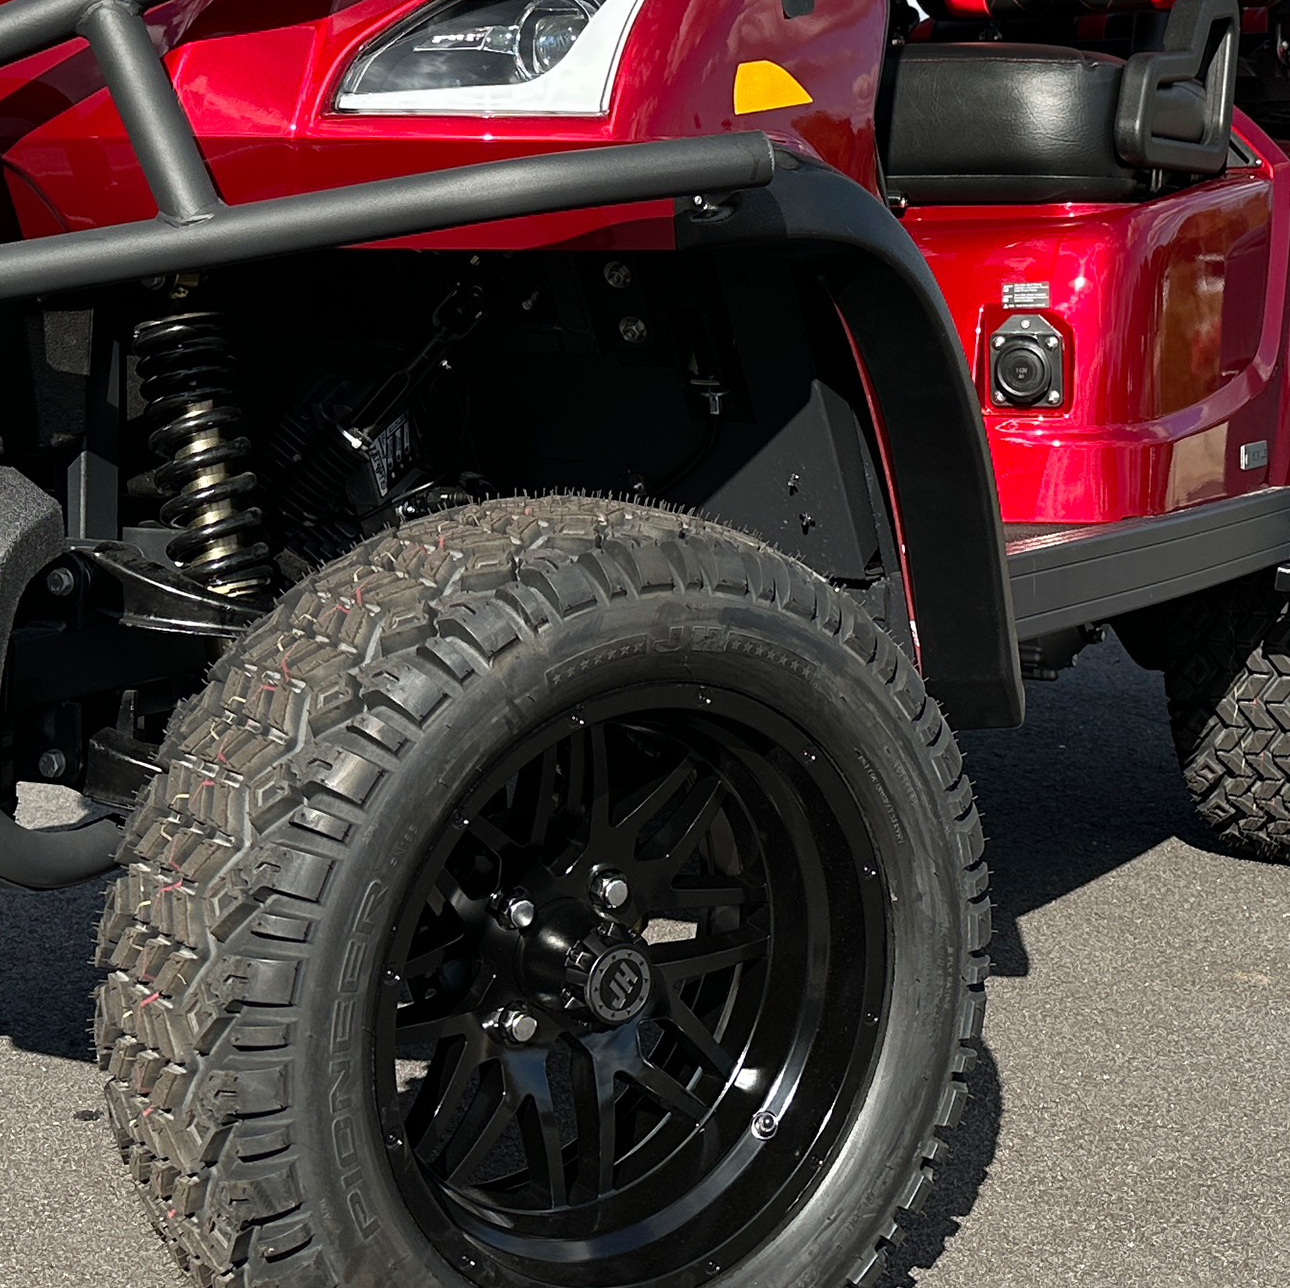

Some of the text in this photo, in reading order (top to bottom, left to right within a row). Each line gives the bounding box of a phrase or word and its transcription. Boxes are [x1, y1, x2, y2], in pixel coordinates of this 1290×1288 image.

[653, 626, 727, 654] JH
[608, 961, 639, 1010] JH
[329, 878, 391, 1242] PIONEER
